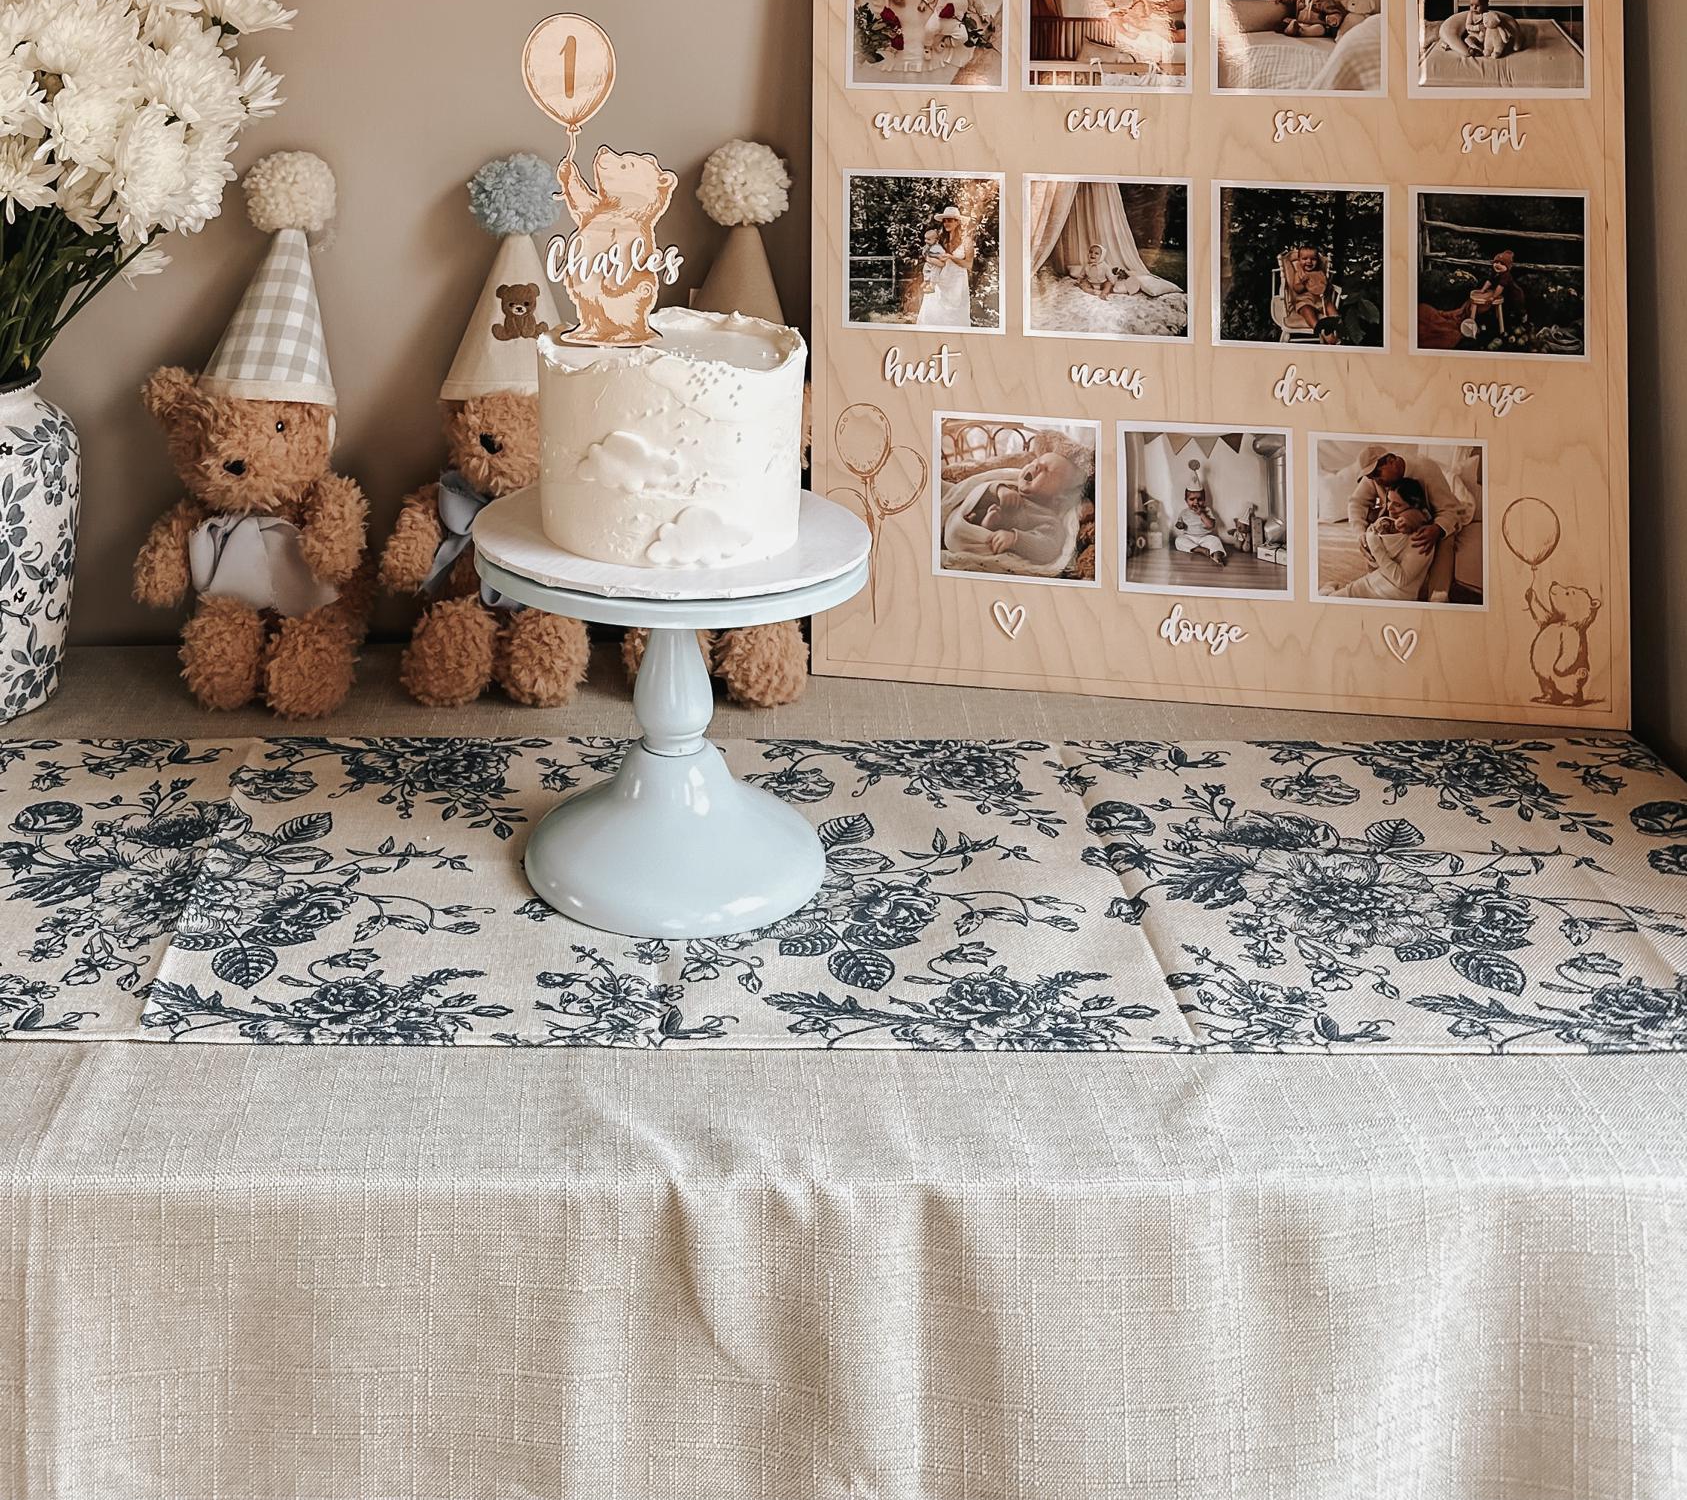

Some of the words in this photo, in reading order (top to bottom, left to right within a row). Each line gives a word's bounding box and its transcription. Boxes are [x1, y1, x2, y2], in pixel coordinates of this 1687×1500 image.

[559, 35, 577, 99] 1
[873, 100, 973, 140] quatre
[1065, 105, 1146, 140] cinq
[1273, 107, 1324, 142] six
[1460, 107, 1531, 155] sept
[546, 235, 685, 286] Charles
[883, 344, 962, 388] huit
[1070, 362, 1147, 400] neuf
[1274, 364, 1330, 406] dix
[1461, 381, 1533, 418] onze
[1159, 604, 1250, 656] douze
